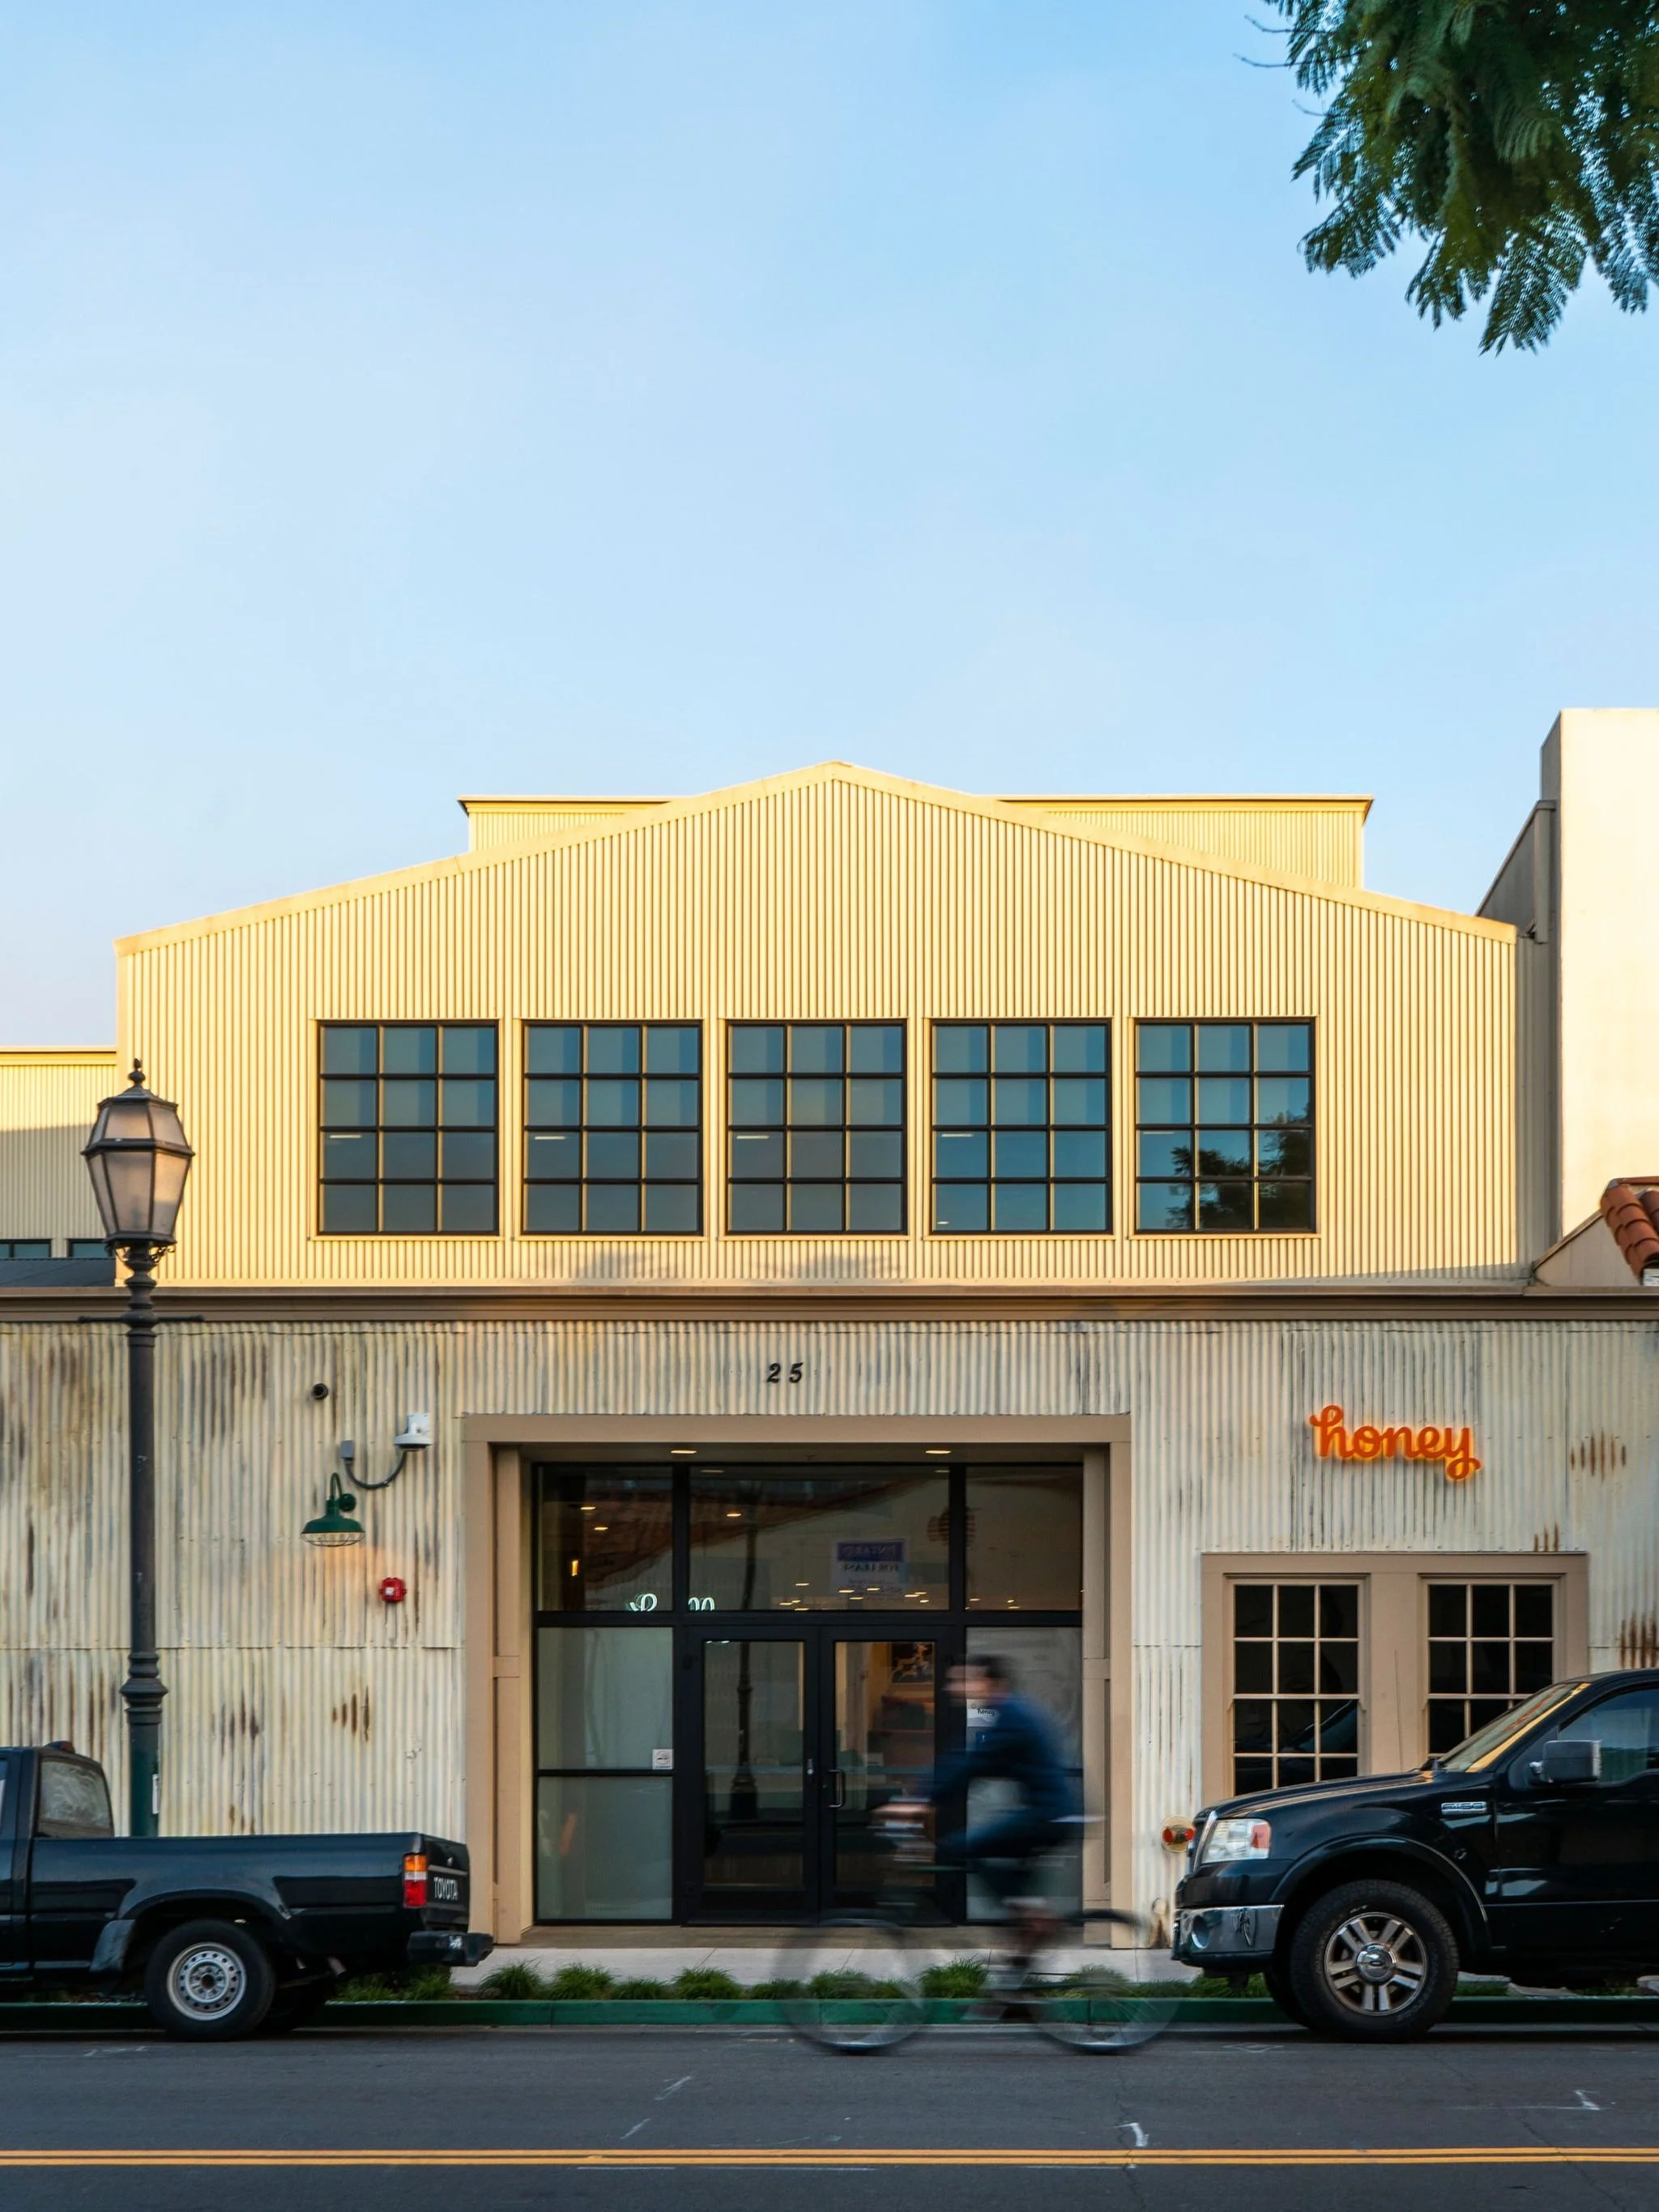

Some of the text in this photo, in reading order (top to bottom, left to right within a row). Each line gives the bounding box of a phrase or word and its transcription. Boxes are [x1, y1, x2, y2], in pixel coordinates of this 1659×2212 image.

[766, 1361, 804, 1383] 25
[1309, 1404, 1481, 1480] honey
[433, 1876, 459, 1901] TOYOTA
